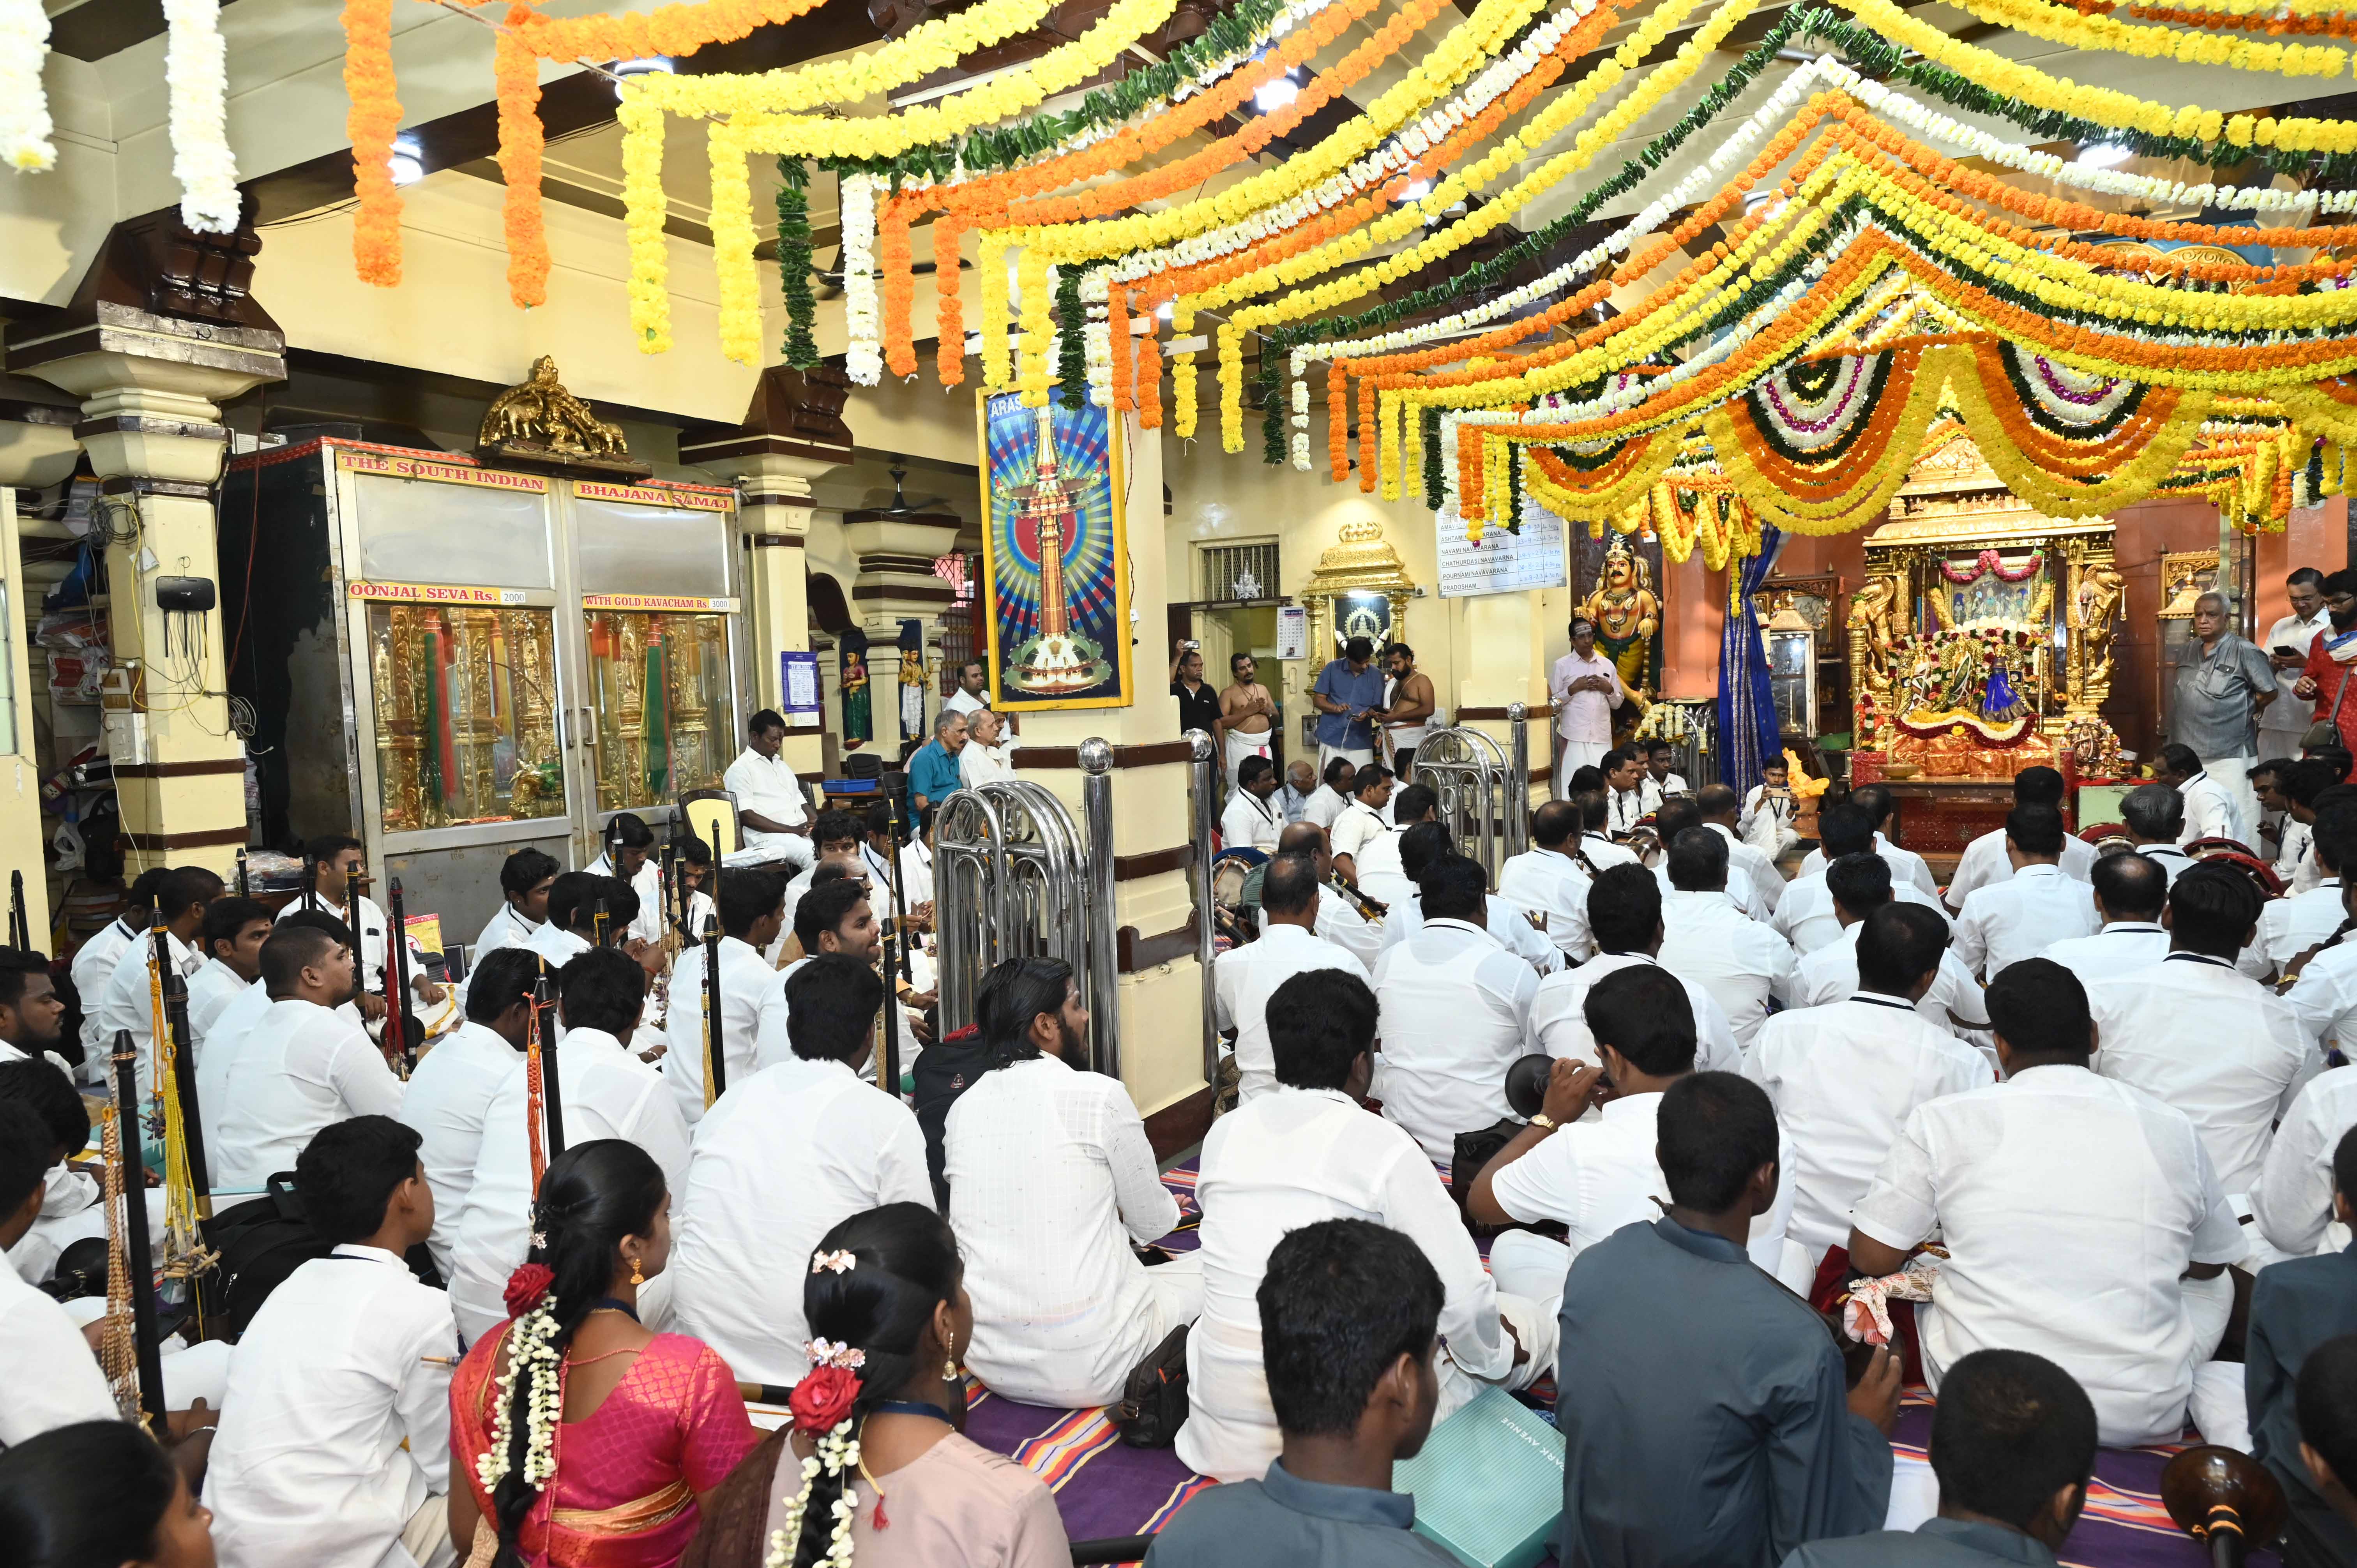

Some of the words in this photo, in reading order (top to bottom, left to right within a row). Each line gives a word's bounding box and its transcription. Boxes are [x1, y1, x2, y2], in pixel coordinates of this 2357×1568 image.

[991, 395, 1023, 418] ARAS
[341, 455, 389, 471] THE
[396, 461, 470, 480] SOUTH
[475, 471, 544, 490] INDIAN
[580, 484, 668, 502] BHAJANA
[672, 494, 728, 509] SAMAJ
[1441, 522, 1467, 530] AMAVASA
[1465, 530, 1501, 540] NARANA
[1463, 543, 1499, 552] NAVAVARANA
[1442, 558, 1479, 567] CHATHURDASI
[1481, 554, 1514, 563] NAVAVARNA
[1443, 571, 1470, 579] POURNAMI
[1472, 567, 1508, 576] NAVAVARANA
[350, 584, 421, 598] OONJAL
[427, 588, 470, 600] SEVA
[474, 590, 496, 601] Rs.
[504, 593, 524, 602] 2000
[1443, 583, 1476, 591] PRADOSHAM
[586, 596, 611, 606] WITH
[615, 597, 641, 607] GOLD
[644, 598, 694, 608] KAVACHAM
[697, 599, 709, 608] Rs.
[1500, 1417, 1541, 1446] AVENUE
